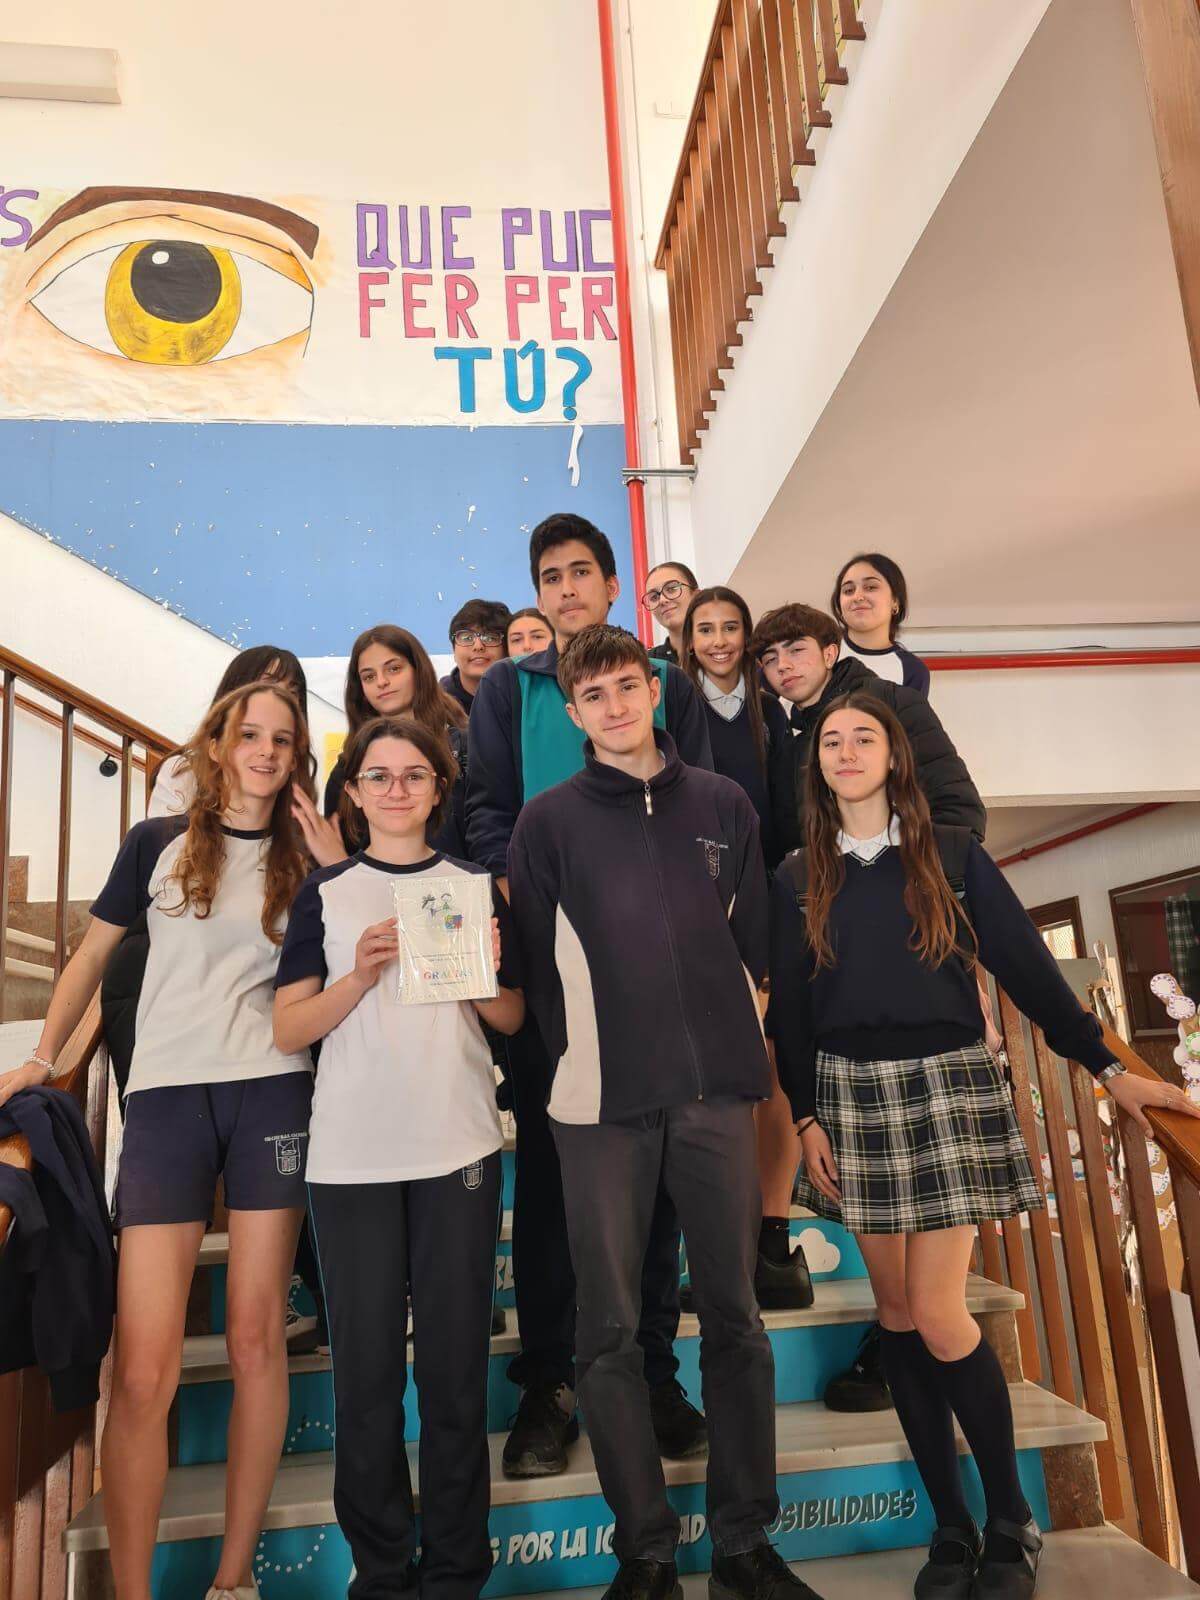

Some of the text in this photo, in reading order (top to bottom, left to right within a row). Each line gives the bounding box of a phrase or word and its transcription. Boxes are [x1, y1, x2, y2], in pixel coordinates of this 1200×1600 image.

[0, 185, 39, 247] S
[356, 203, 616, 272] QUE PUC
[358, 272, 618, 340] FER PER
[433, 339, 593, 421] TÚ?
[506, 1530, 555, 1565] POR
[559, 1526, 588, 1559] LA
[768, 1487, 917, 1535] OSIBILIDADES
